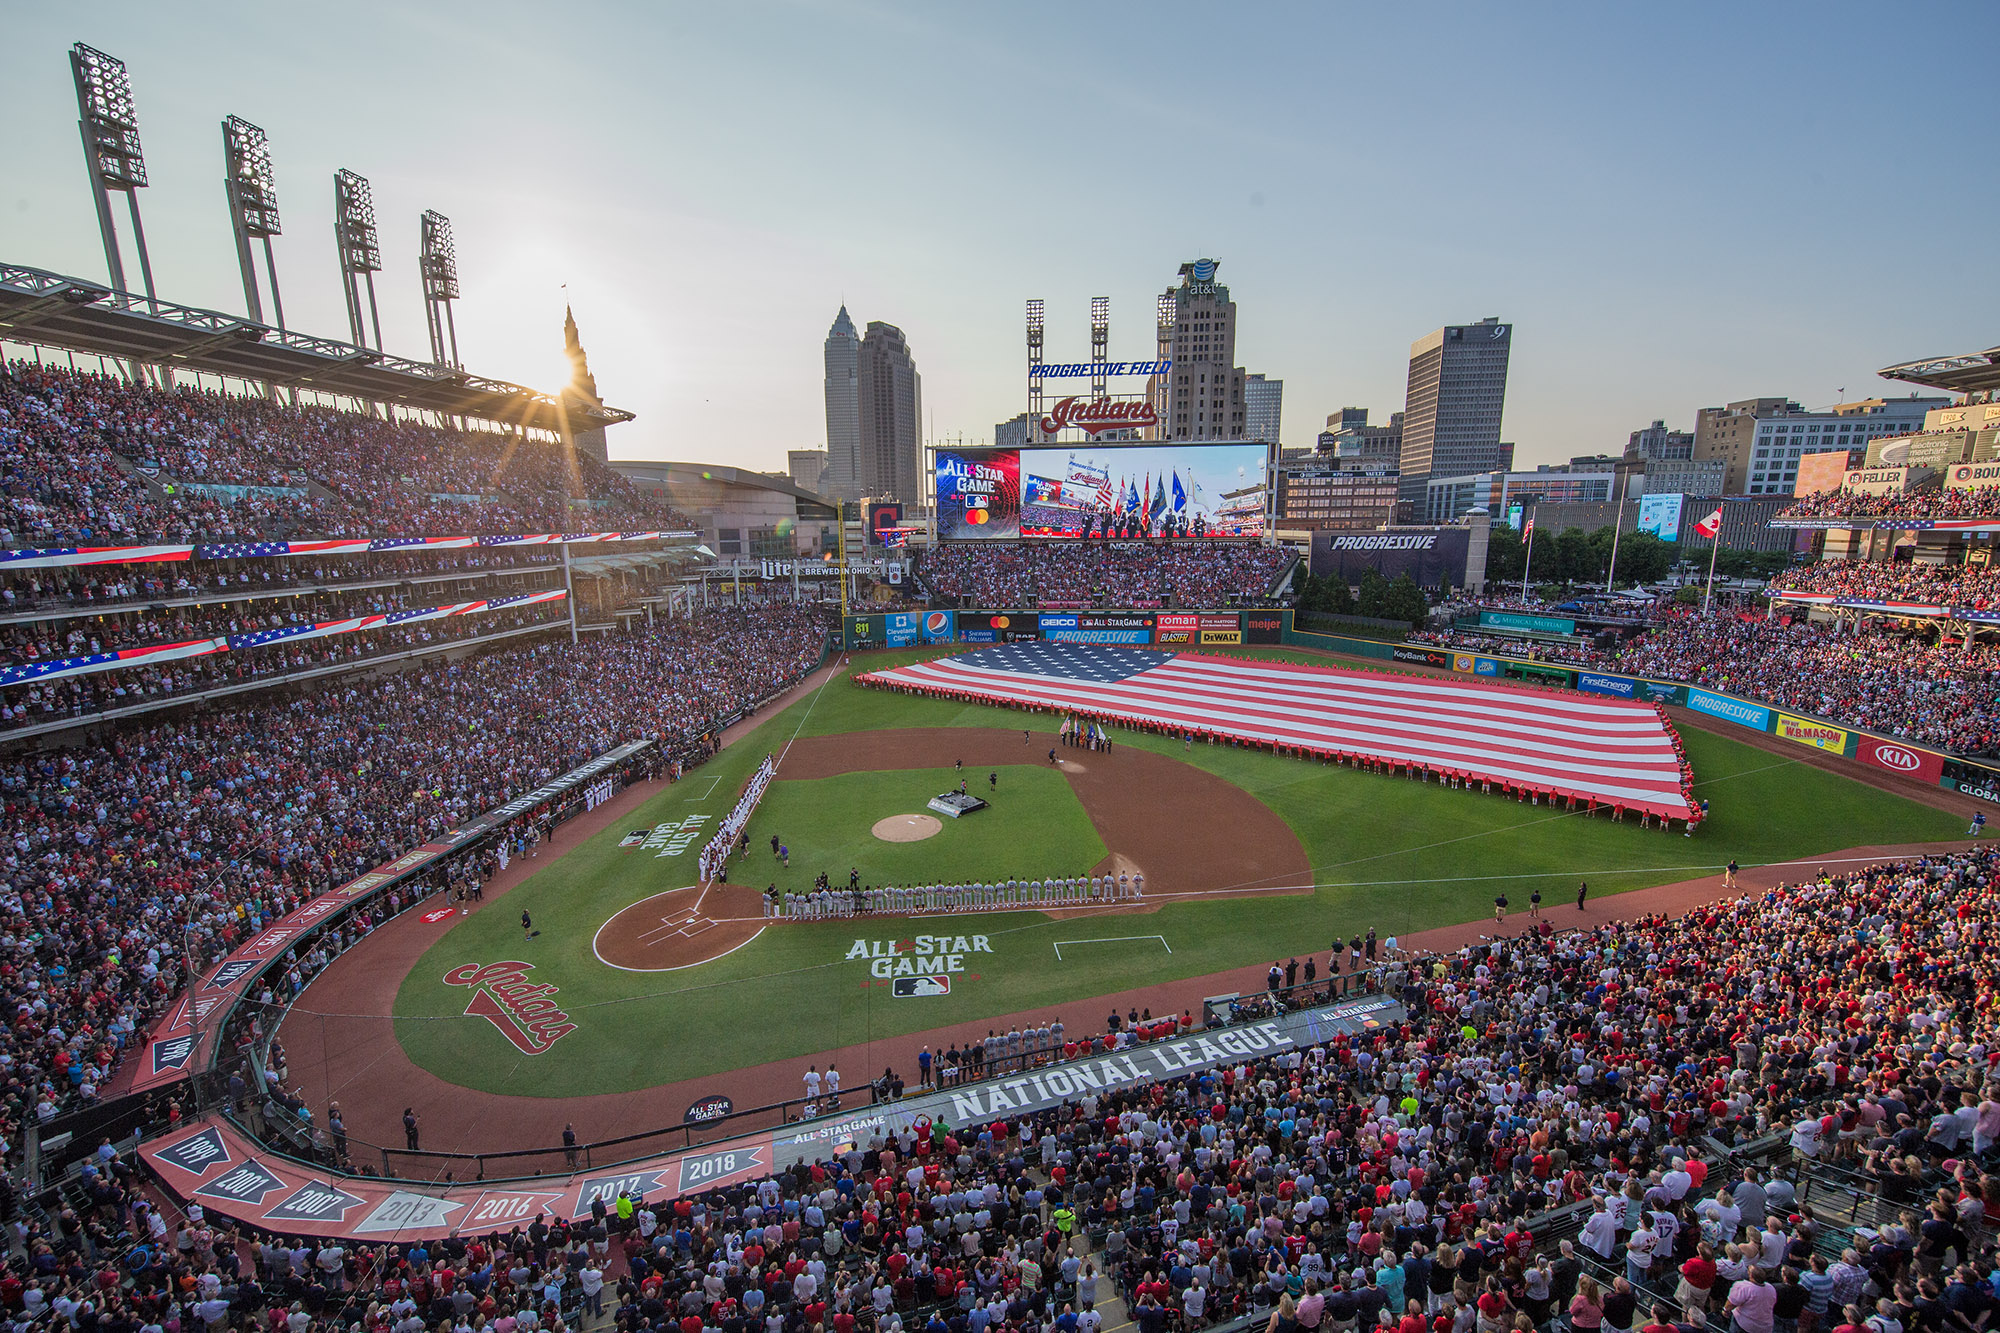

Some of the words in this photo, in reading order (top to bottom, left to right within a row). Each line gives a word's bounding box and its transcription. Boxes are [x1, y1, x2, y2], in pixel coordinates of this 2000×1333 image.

[1190, 283, 1216, 295] at&t
[1029, 362, 1129, 378] PROGRESSIVE
[1128, 360, 1172, 375] FIELD
[1041, 396, 1158, 436] Indians
[1909, 447, 1947, 457] merchant
[1910, 440, 1950, 450] electronic
[943, 459, 970, 477] ALL
[976, 464, 1005, 483] STAR
[1850, 475, 1860, 483] 19
[1863, 471, 1900, 483] FELLER
[1960, 470, 1967, 478] 5
[1973, 466, 2000, 480] BOU
[957, 477, 996, 493] GAME
[874, 507, 897, 540] C
[1331, 535, 1437, 550] PROGRESSIVE
[760, 559, 792, 581] Lite
[805, 568, 840, 576] BREWED
[851, 567, 870, 575] OHIO
[855, 622, 869, 633] 811
[1124, 618, 1143, 627] GAME
[1160, 617, 1196, 625] roman
[1248, 618, 1281, 631] meijer
[1502, 616, 1532, 626] MEDICAL
[1533, 619, 1563, 629] MUTUAL
[886, 627, 917, 636] Cleveland
[1055, 631, 1139, 644] PROGRESSIVE
[1160, 633, 1190, 643] BLASTER
[1393, 650, 1427, 662] KeyBank
[1582, 676, 1633, 693] FirstEnergy
[1691, 694, 1763, 723] PROGRESSIVE
[1882, 748, 1912, 768] KIA
[492, 785, 557, 816] LEAGUE
[1960, 783, 2000, 804] GLOBA
[640, 822, 681, 850] GAME
[654, 831, 700, 859] STAR
[303, 901, 336, 916] 1954
[257, 929, 293, 946] 1995
[845, 939, 903, 960] ALL
[915, 935, 994, 955] STAR
[215, 962, 252, 981] 1996
[871, 954, 965, 979] GAME
[443, 960, 579, 1056] Indians
[1321, 1010, 1341, 1021] ALL
[1338, 1007, 1362, 1017] STAR
[1360, 1002, 1387, 1013] GAME
[160, 1037, 192, 1062] 1998
[949, 1055, 1152, 1122] NATIONAL
[1150, 1022, 1295, 1073] LEAGUE
[688, 1106, 705, 1116] ALL
[707, 1101, 729, 1112] STAR
[793, 1132, 817, 1145] ALL
[820, 1125, 851, 1138] STAR
[850, 1115, 886, 1130] GAME
[174, 1135, 221, 1164] 1999
[688, 1153, 736, 1180] 2018
[215, 1168, 270, 1198] 2001
[588, 1177, 642, 1203] 2017
[283, 1189, 339, 1216] 2007
[474, 1196, 533, 1220] 2016
[1615, 1207, 1627, 1219] 25
[1658, 1226, 1673, 1239] 17
[1307, 1263, 1319, 1272] 99
[1086, 1319, 1093, 1328] 2
